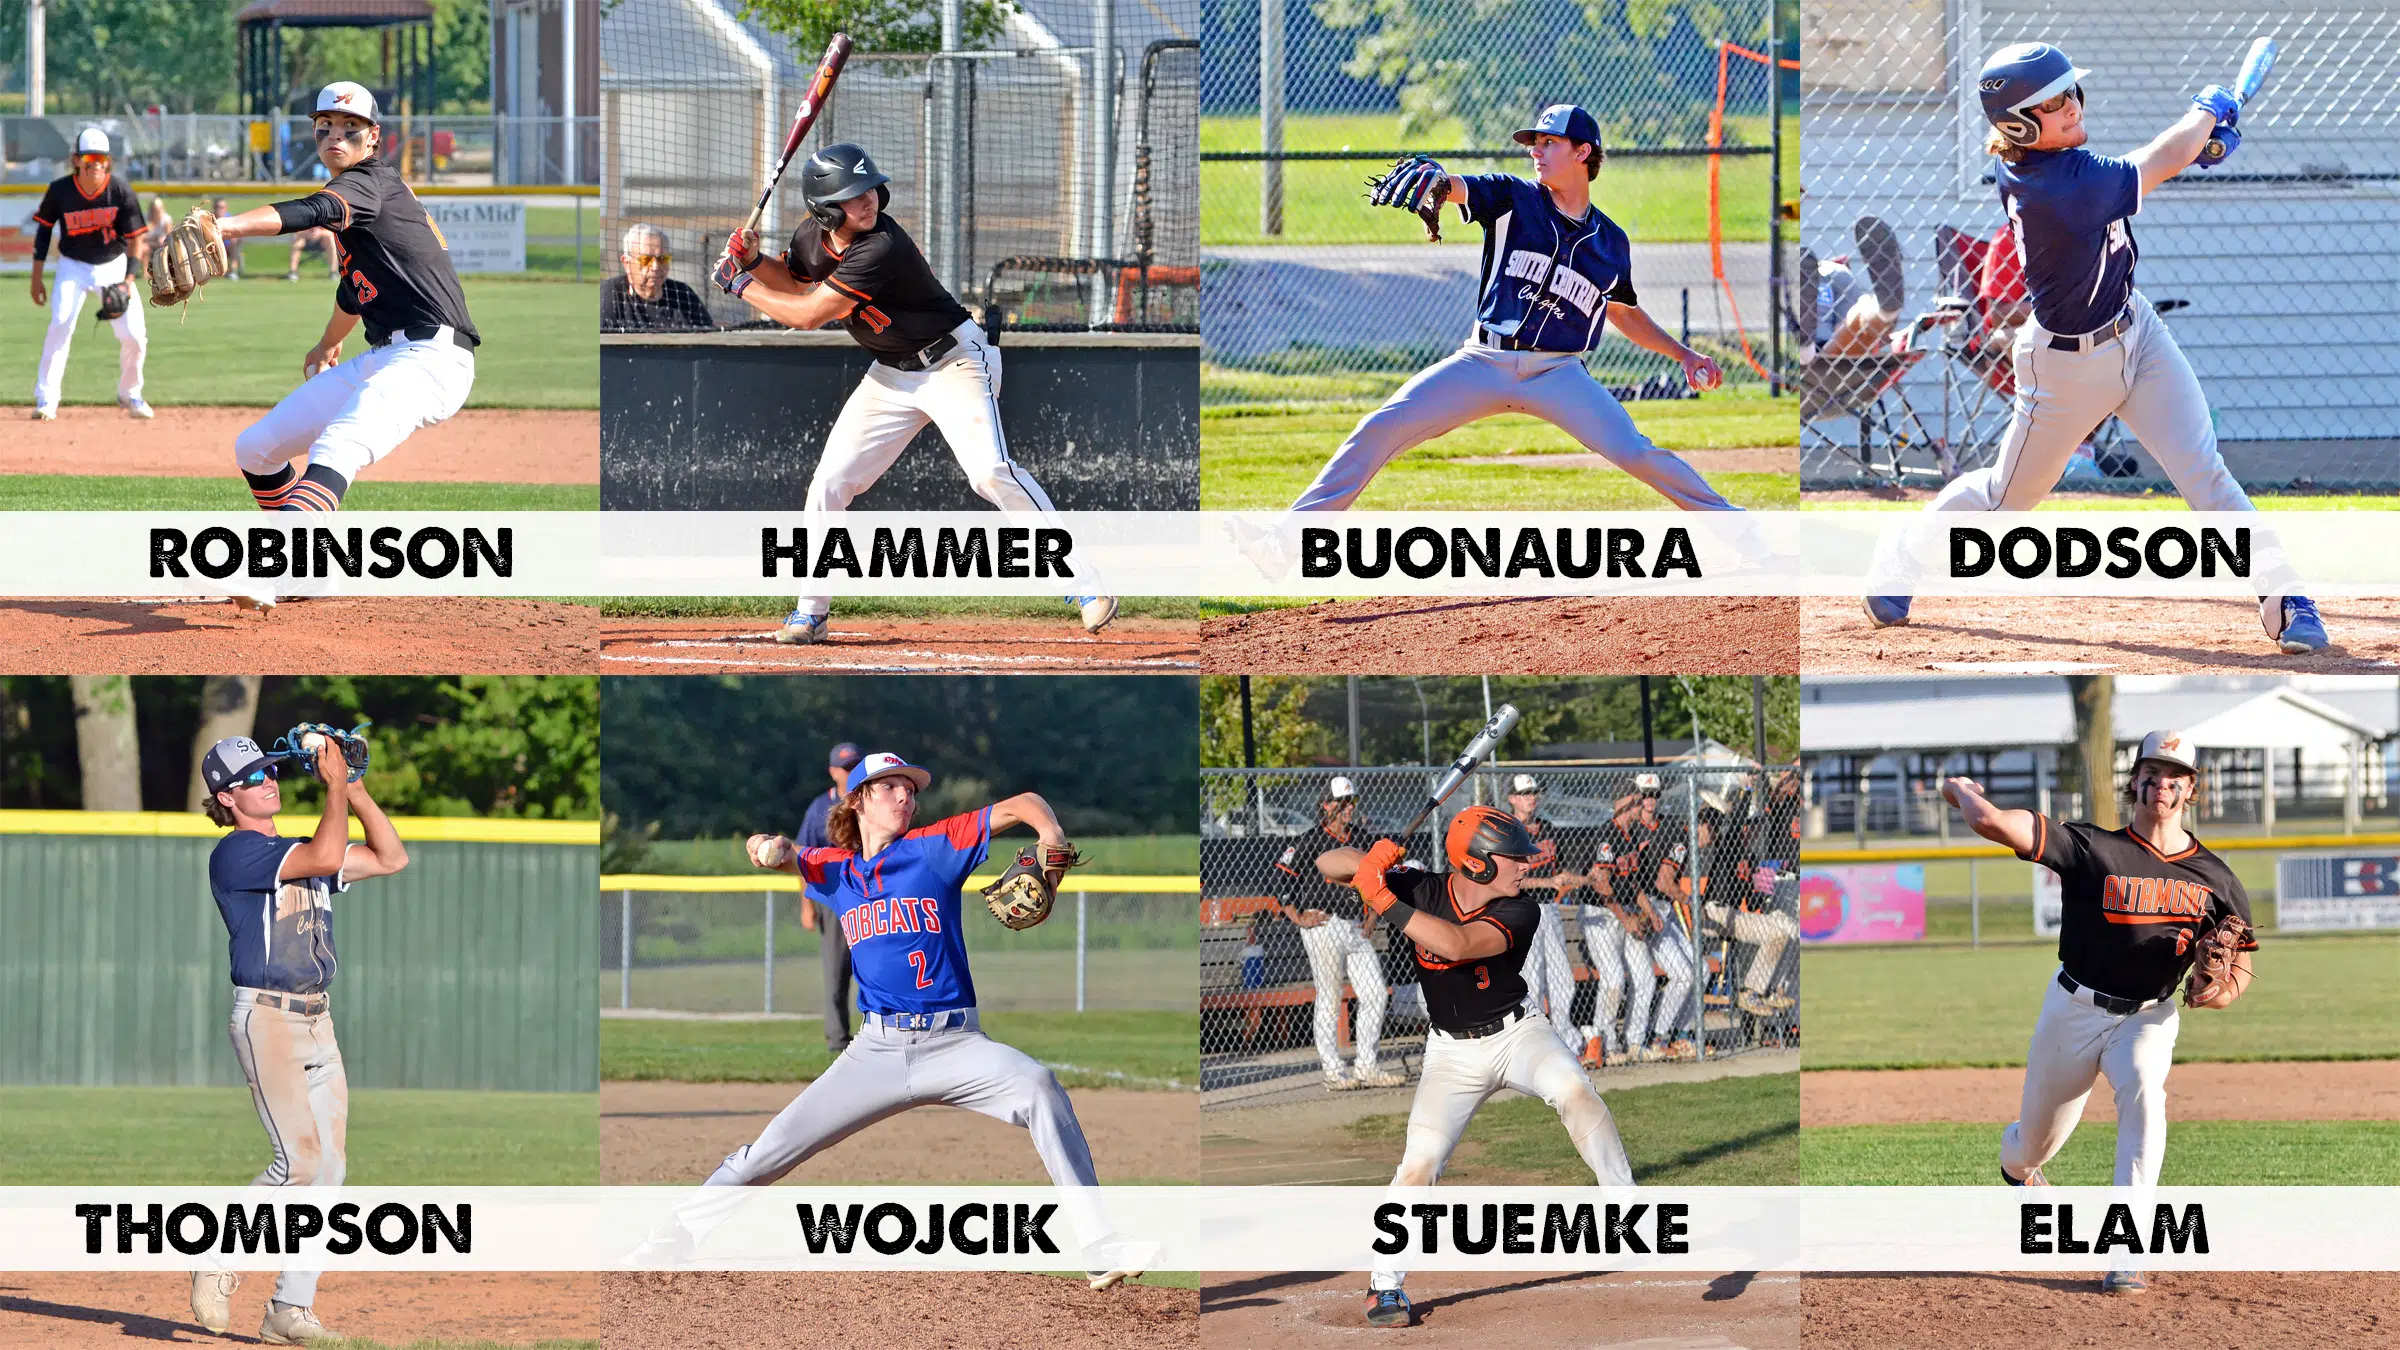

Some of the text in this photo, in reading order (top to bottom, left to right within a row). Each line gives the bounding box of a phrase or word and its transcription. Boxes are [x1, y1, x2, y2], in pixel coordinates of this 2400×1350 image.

[423, 202, 470, 223] irst
[1505, 250, 1601, 319] SOUTH CENTRAL
[236, 740, 260, 754] SC
[2103, 875, 2214, 916] ALTAMONT
[908, 950, 933, 989] 2
[1475, 966, 1490, 989] 3
